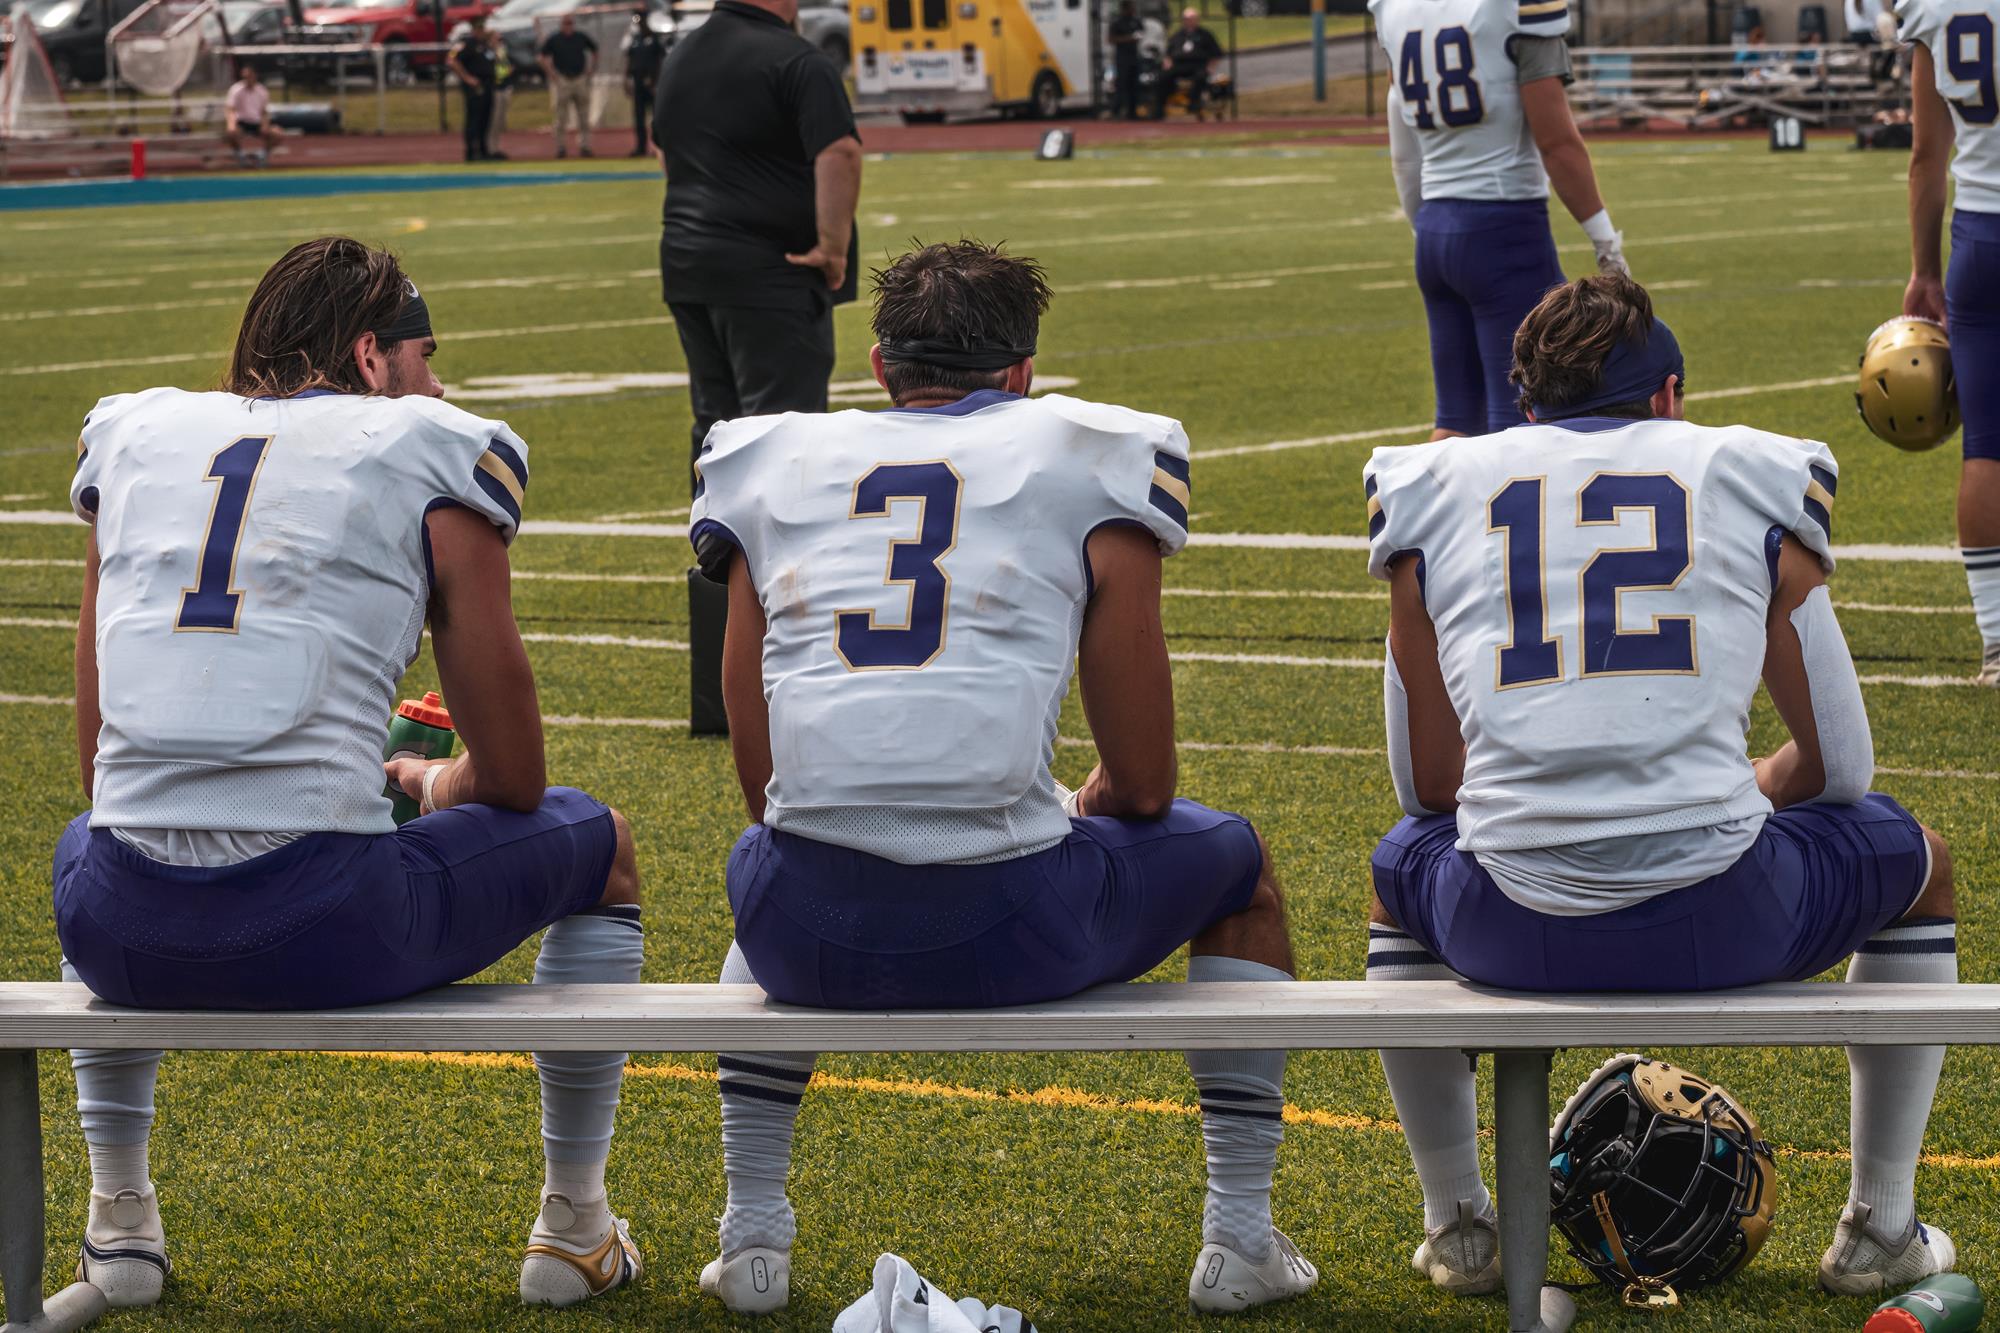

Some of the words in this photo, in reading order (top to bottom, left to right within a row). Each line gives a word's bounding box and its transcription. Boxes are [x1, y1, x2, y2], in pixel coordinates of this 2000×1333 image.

[1398, 25, 1486, 130] 48
[1774, 117, 1799, 147] 10
[1945, 11, 1999, 128] 9
[173, 434, 276, 635] 1
[833, 457, 965, 673] 3
[1486, 471, 1700, 692] 12
